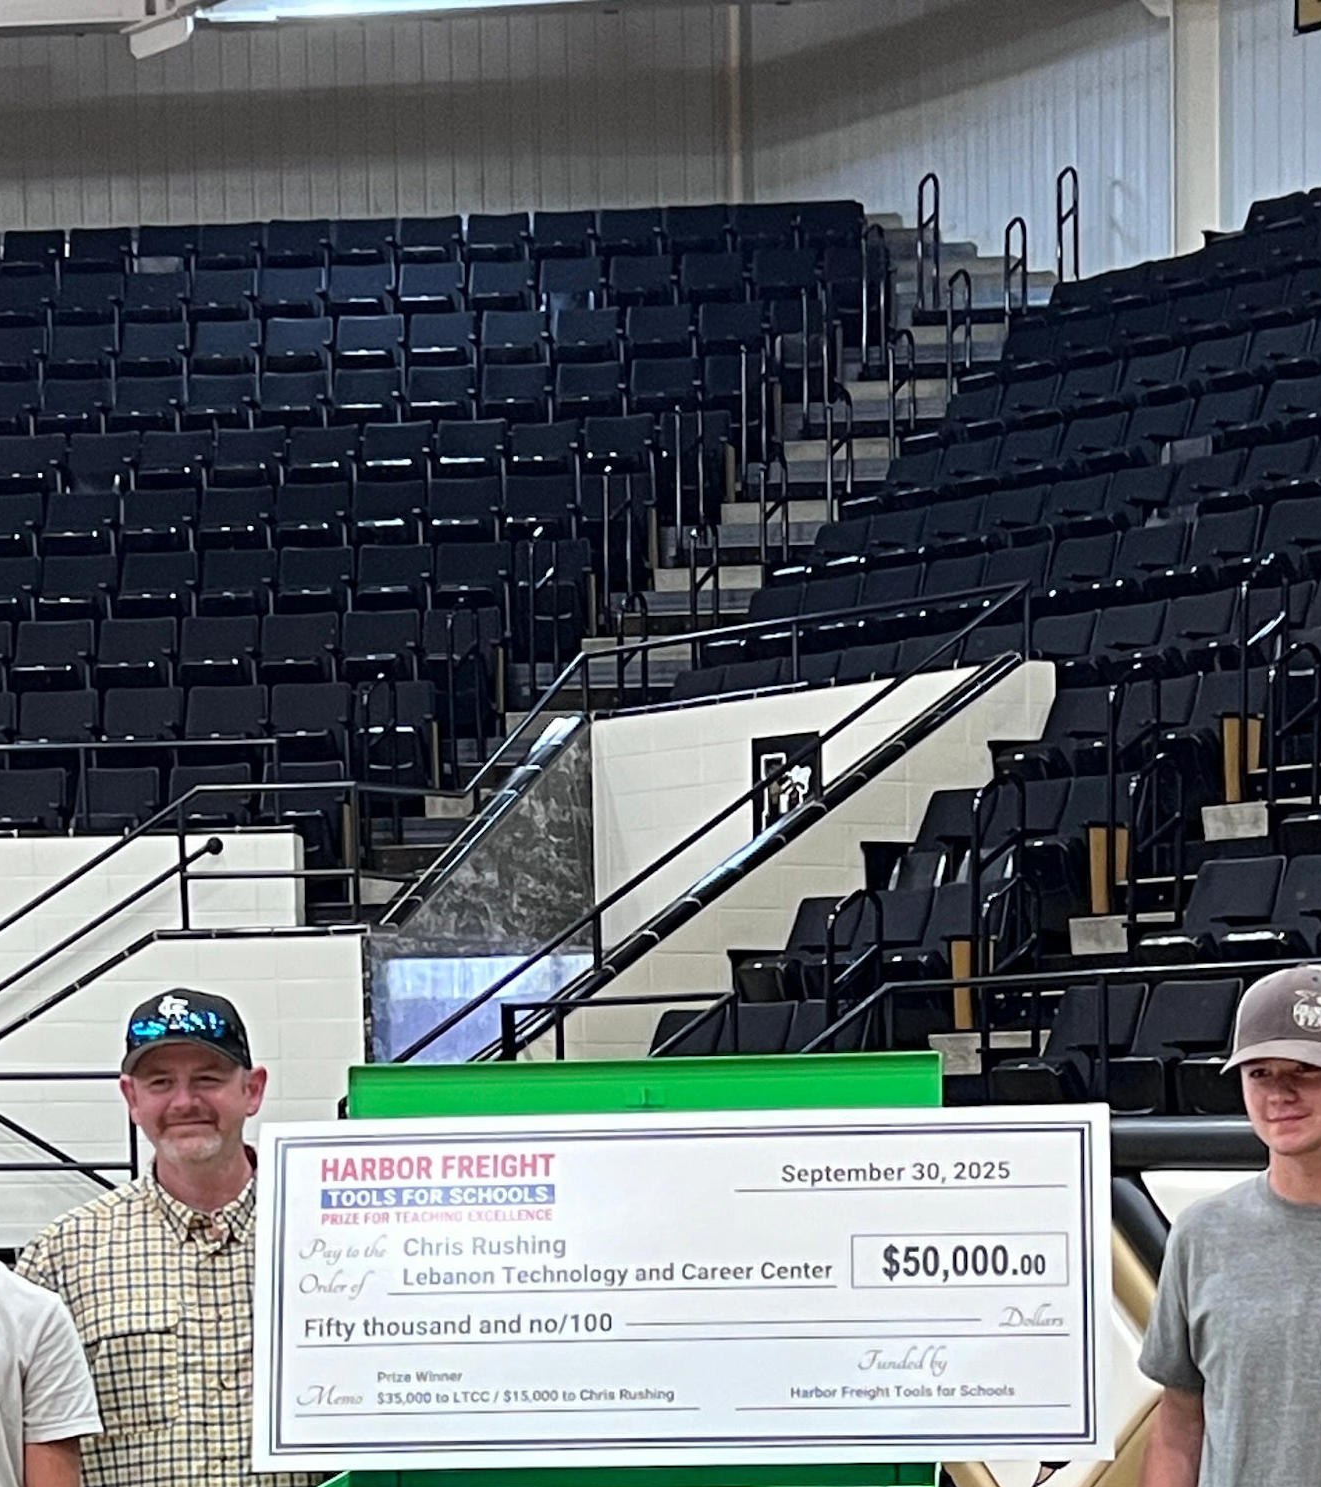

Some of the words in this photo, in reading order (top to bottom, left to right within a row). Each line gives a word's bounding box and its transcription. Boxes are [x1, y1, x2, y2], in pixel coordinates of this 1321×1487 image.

[321, 1156, 432, 1182] HARBOR
[441, 1153, 555, 1179] FREIGHT
[781, 1162, 905, 1186] September
[912, 1162, 946, 1184] 30,
[953, 1161, 1010, 1180] 2025
[328, 1189, 396, 1207] TOOLS
[401, 1188, 444, 1205] FOR
[449, 1185, 549, 1204] SCHOOLS
[321, 1212, 360, 1225] PRIZE
[364, 1211, 389, 1224] FOR
[396, 1210, 463, 1223] TEACHING
[468, 1208, 553, 1222] EXCELLENCE
[299, 1238, 341, 1266] Pay
[346, 1244, 360, 1258] to
[364, 1234, 387, 1258] the
[403, 1237, 463, 1257] Chris
[472, 1235, 566, 1259] Rushing
[403, 1267, 494, 1286] Lebanon
[503, 1264, 628, 1287] Technology
[635, 1263, 674, 1281] and
[681, 1263, 753, 1280] Career
[760, 1261, 833, 1280] Center
[882, 1244, 1046, 1282] $50,000.00
[299, 1269, 347, 1294] Order
[350, 1270, 375, 1300] of
[304, 1317, 355, 1342] Fifty
[363, 1315, 471, 1336] thousand
[479, 1314, 521, 1333] and
[529, 1312, 613, 1334] no/100
[999, 1303, 1064, 1327] Dollars
[858, 1346, 928, 1371] Funded
[929, 1345, 948, 1377] by
[378, 1371, 411, 1383] Prize
[416, 1370, 463, 1383] Winner
[296, 1385, 363, 1406] Memo
[377, 1391, 431, 1405] $35,000
[436, 1391, 449, 1403] to
[453, 1391, 490, 1403] LTCC
[504, 1389, 558, 1402] $15,000
[563, 1389, 576, 1401] to
[580, 1388, 615, 1401] Chris
[620, 1387, 675, 1402] Rushing
[790, 1386, 837, 1399] Harbor
[841, 1385, 890, 1401] Freight
[895, 1384, 932, 1398] Tools
[937, 1384, 956, 1397] for
[961, 1384, 1015, 1398] Schools
